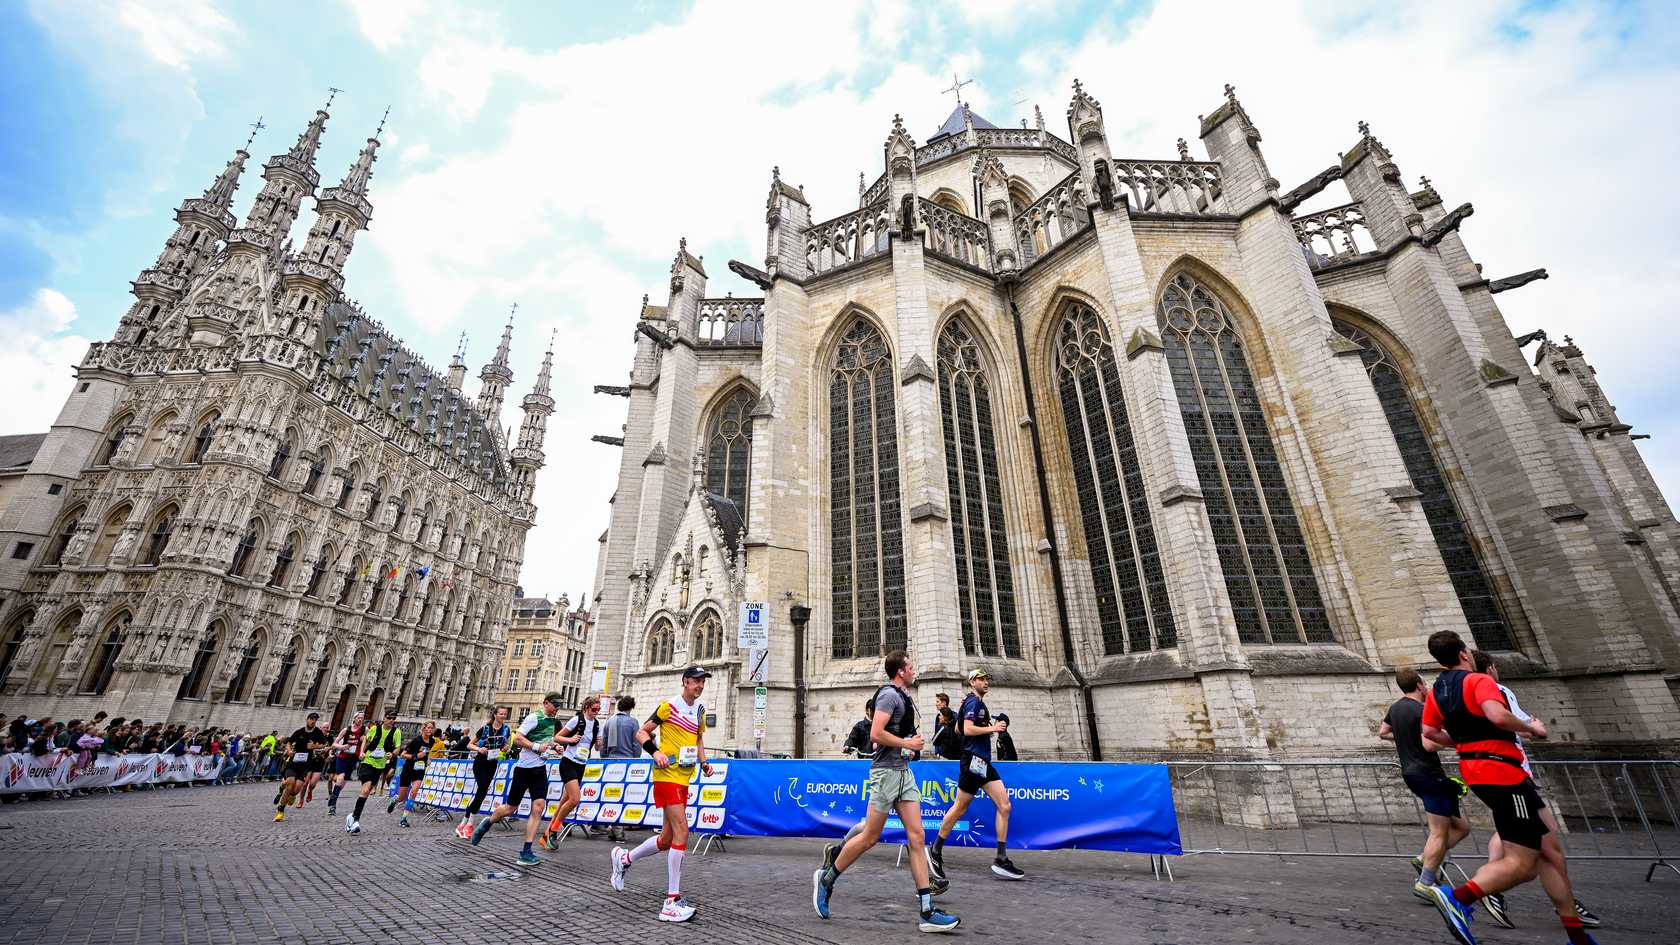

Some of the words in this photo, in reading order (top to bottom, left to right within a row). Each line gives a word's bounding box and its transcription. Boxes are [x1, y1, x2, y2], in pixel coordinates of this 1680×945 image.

[27, 763, 57, 778] leuven
[583, 786, 597, 797] lotto
[806, 783, 858, 795] EUROPEAN
[974, 787, 1070, 801] CHPIONSHIPS
[602, 807, 617, 818] lotto
[702, 812, 719, 824] lotto
